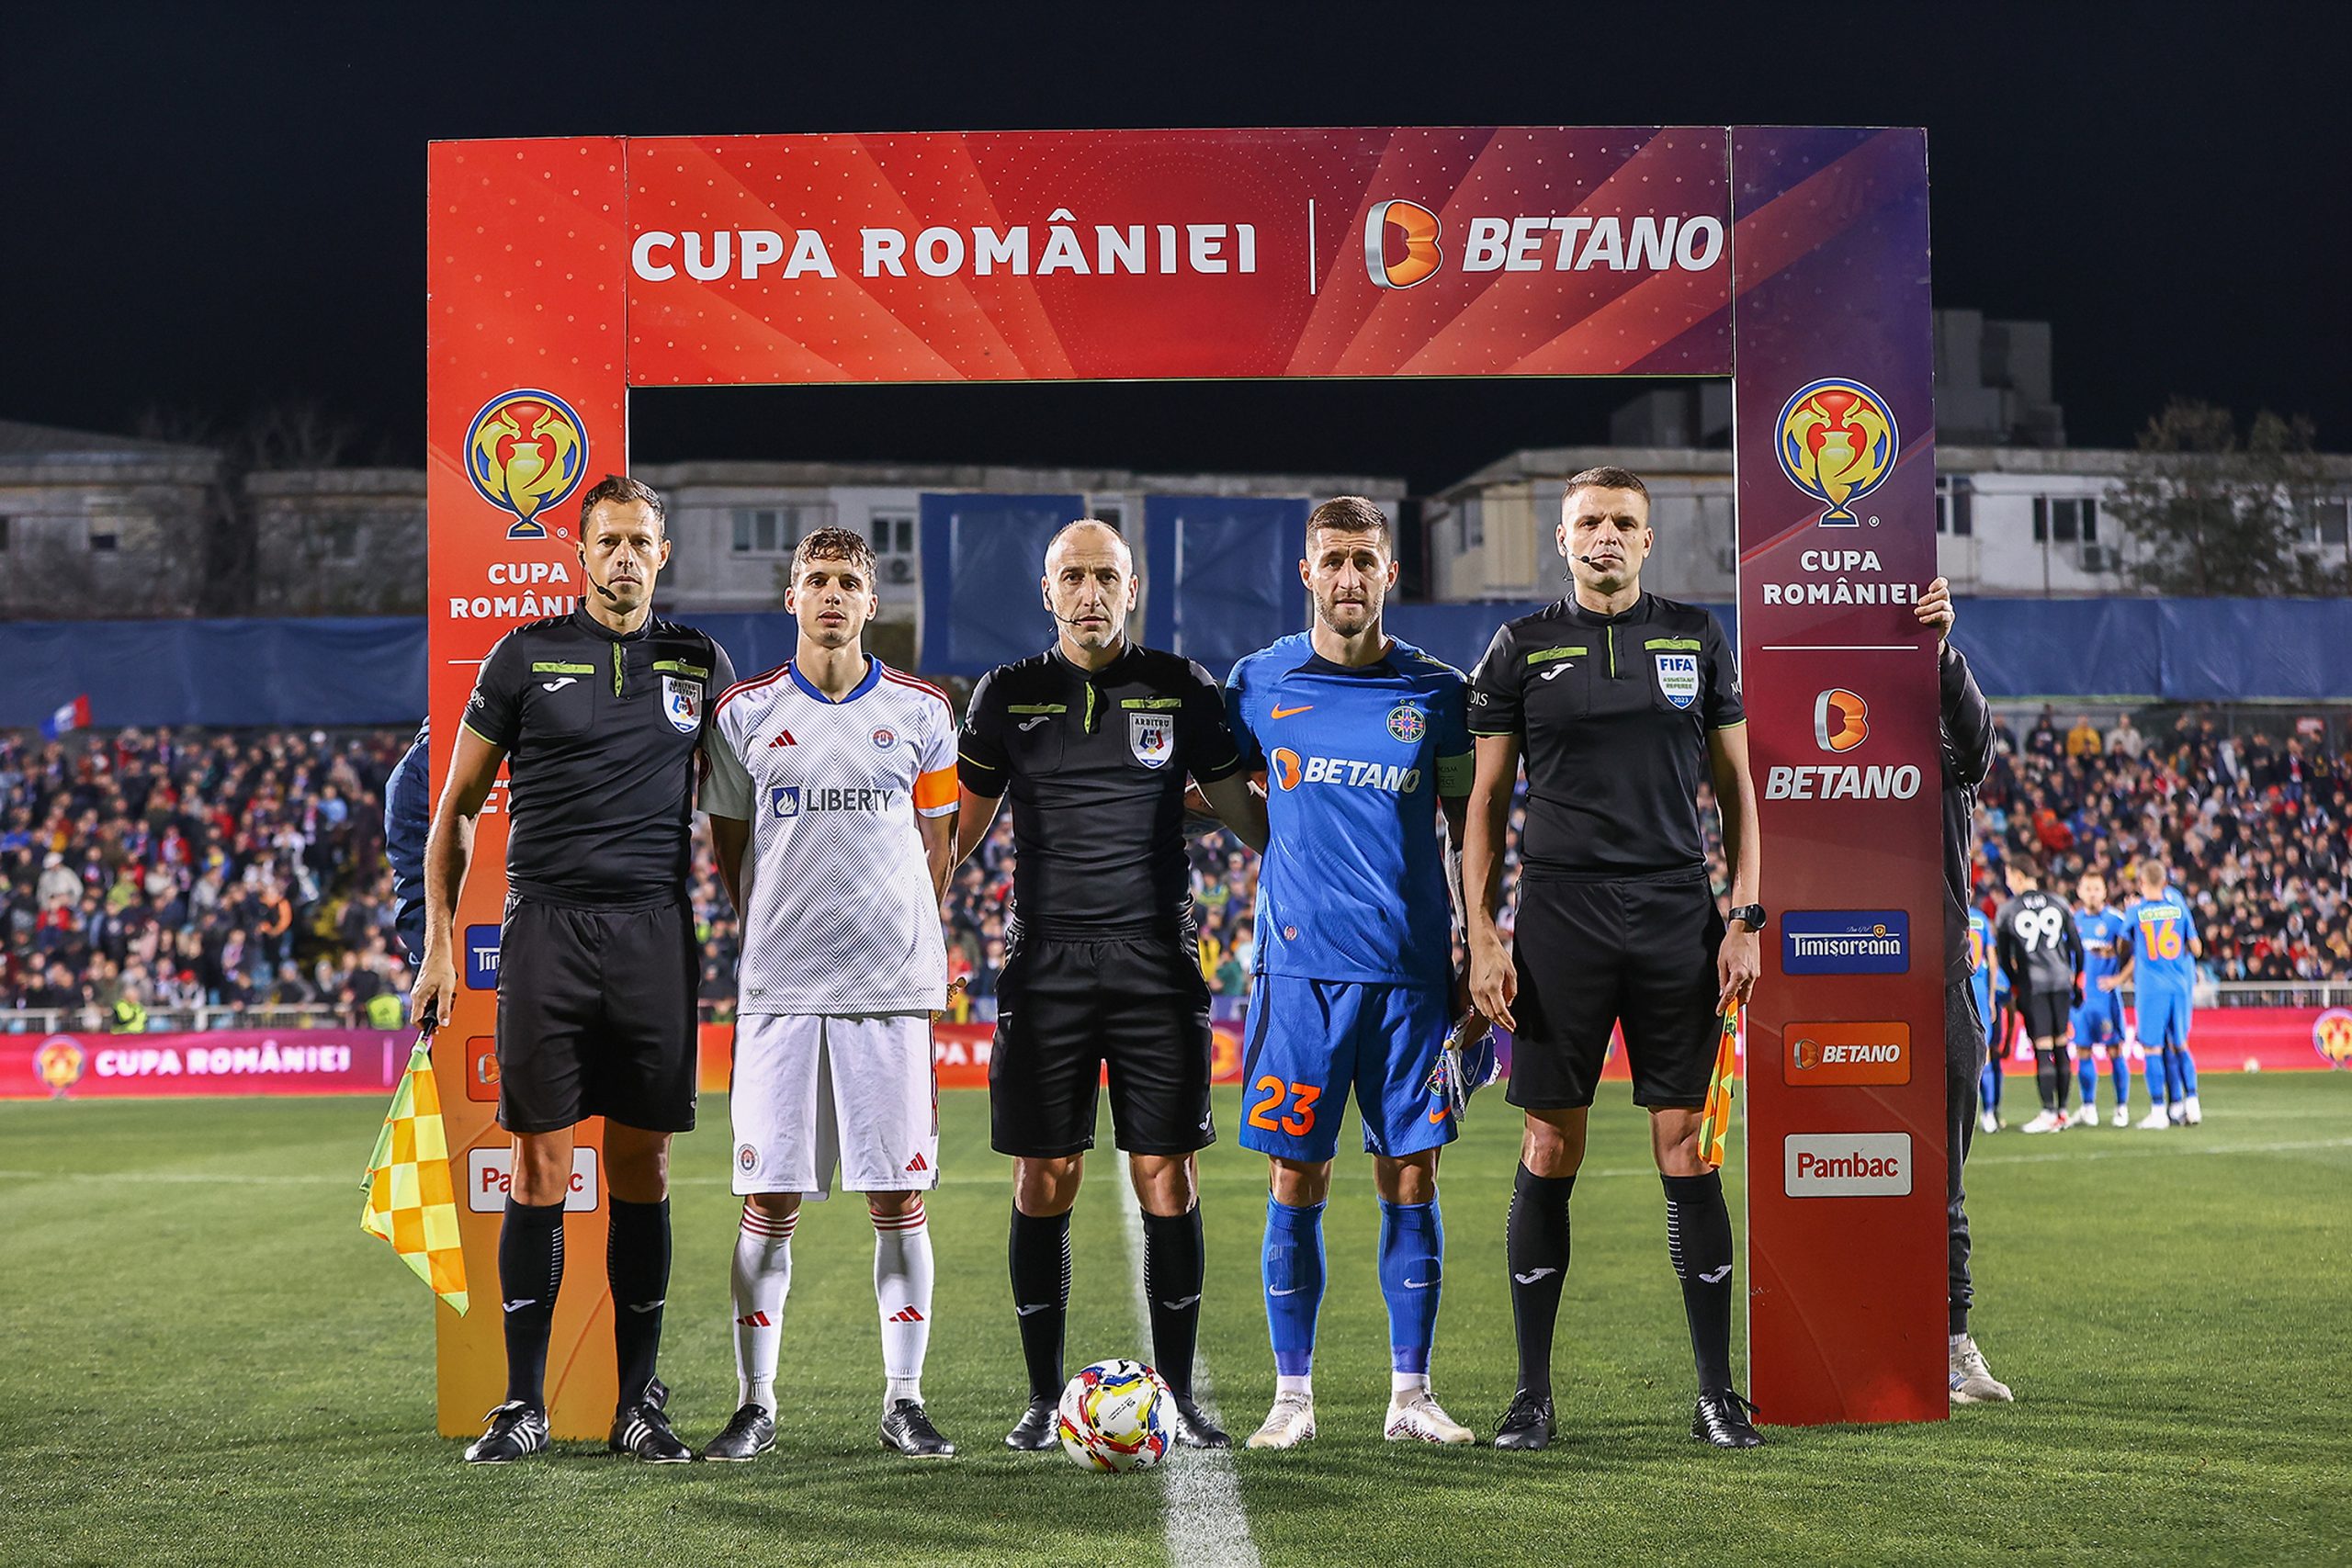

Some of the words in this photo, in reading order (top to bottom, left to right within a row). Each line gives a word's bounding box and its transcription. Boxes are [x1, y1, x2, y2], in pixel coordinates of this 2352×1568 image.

[631, 230, 838, 282] CUPA
[860, 208, 1257, 278] ROMÂNIEI
[1462, 216, 1724, 272] BETANO
[488, 562, 570, 584] CUPA
[1801, 550, 1882, 571] CUPA
[449, 590, 584, 618] ROMÂNI
[1762, 577, 1918, 604] ROMÂNIEI
[1660, 659, 1693, 671] FIFA
[1304, 757, 1421, 794] BETANO
[1765, 765, 1921, 800] BETANO
[806, 788, 894, 812] LIBERTY
[2014, 906, 2063, 953] 99
[2140, 919, 2182, 961] 16
[95, 1048, 182, 1077] CUPA
[186, 1039, 351, 1075] ROMÂNIEI
[1822, 1044, 1900, 1064] BETANO
[1248, 1075, 1322, 1136] 23
[1798, 1153, 1898, 1179] Pambac
